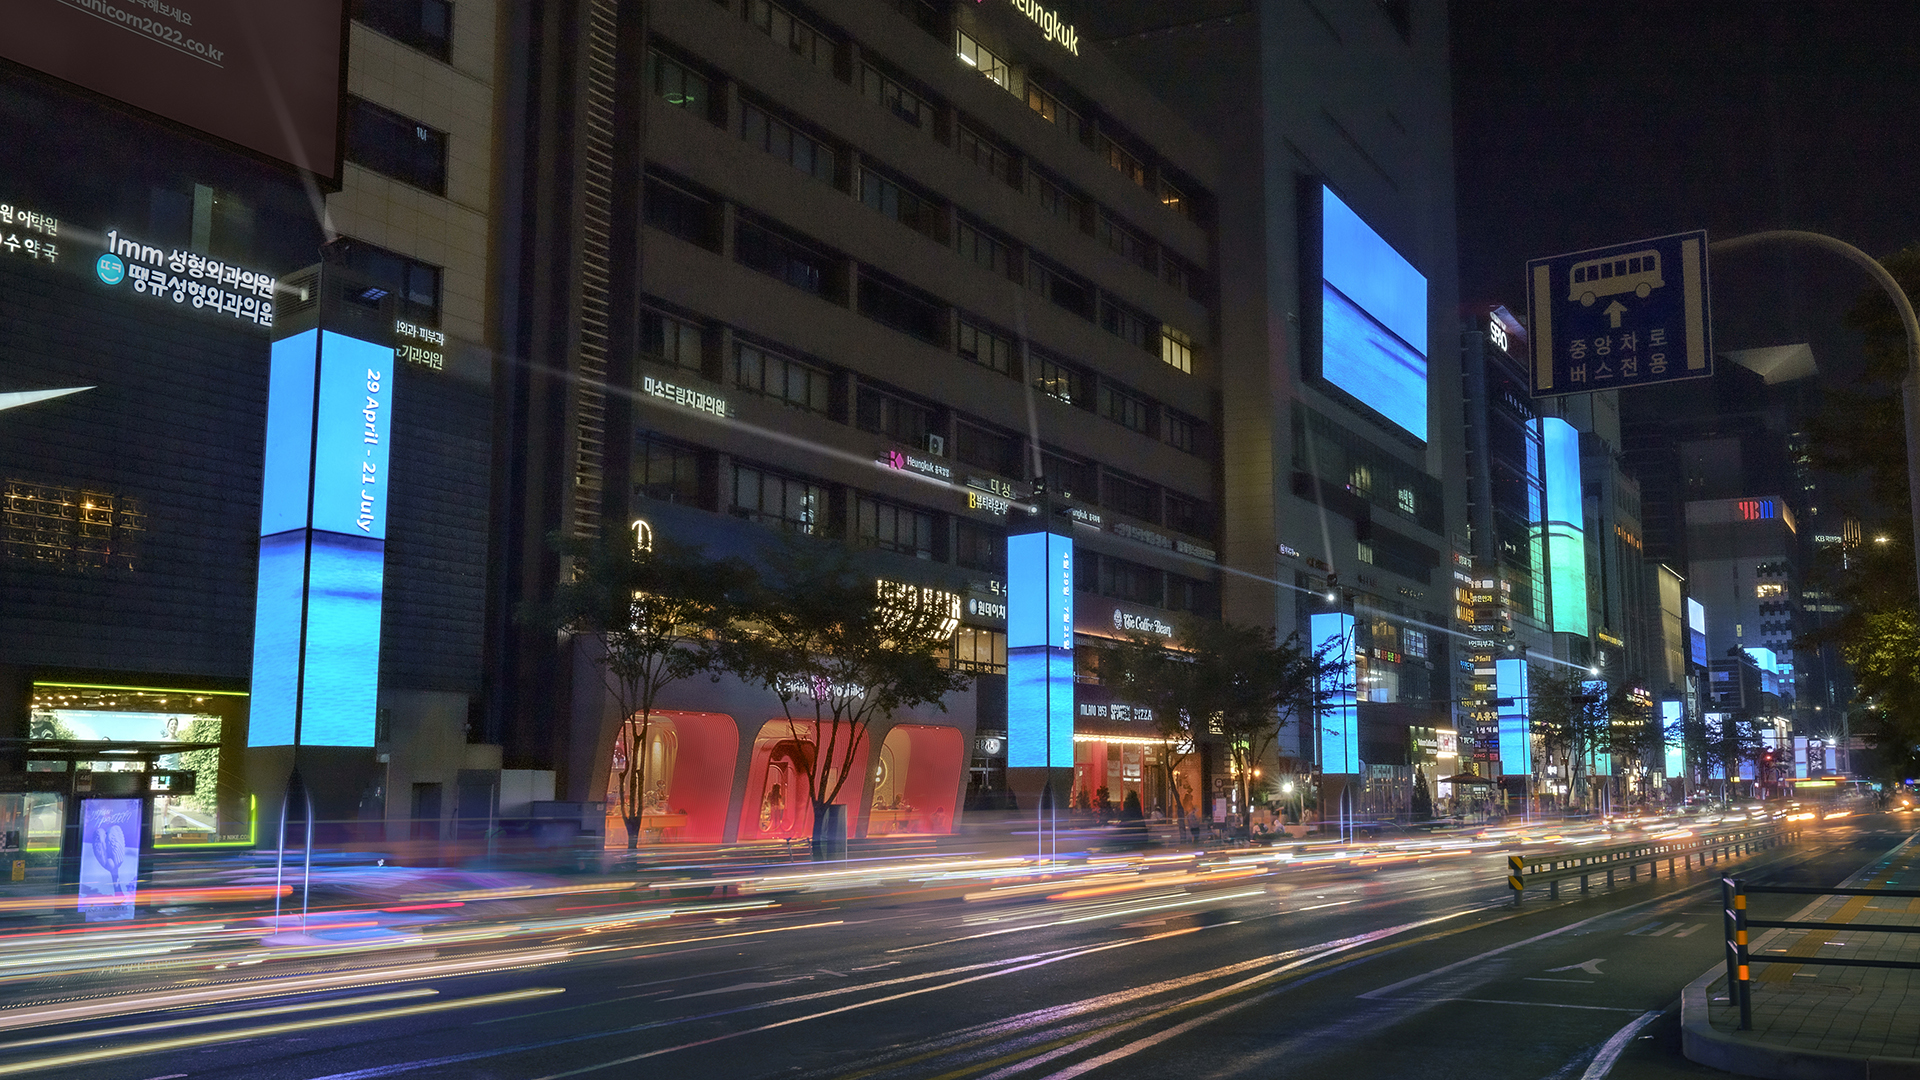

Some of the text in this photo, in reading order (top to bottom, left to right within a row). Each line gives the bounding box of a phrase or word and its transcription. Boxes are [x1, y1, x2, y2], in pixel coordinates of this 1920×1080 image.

[72, 0, 225, 62] unicorn2022.co.kr
[1011, 0, 1079, 57] eungkuk
[17, 210, 58, 237] 어학원
[107, 230, 276, 299] 1mm 성형외과의원
[128, 263, 273, 328] 땡큐성형외과의원
[396, 320, 445, 347] 외과·피부과
[1489, 320, 1508, 352] SPAO
[366, 368, 381, 393] 29
[644, 376, 726, 418] 미소드림치과의원
[363, 396, 379, 445] April
[362, 461, 376, 485] 21
[356, 489, 375, 533] July
